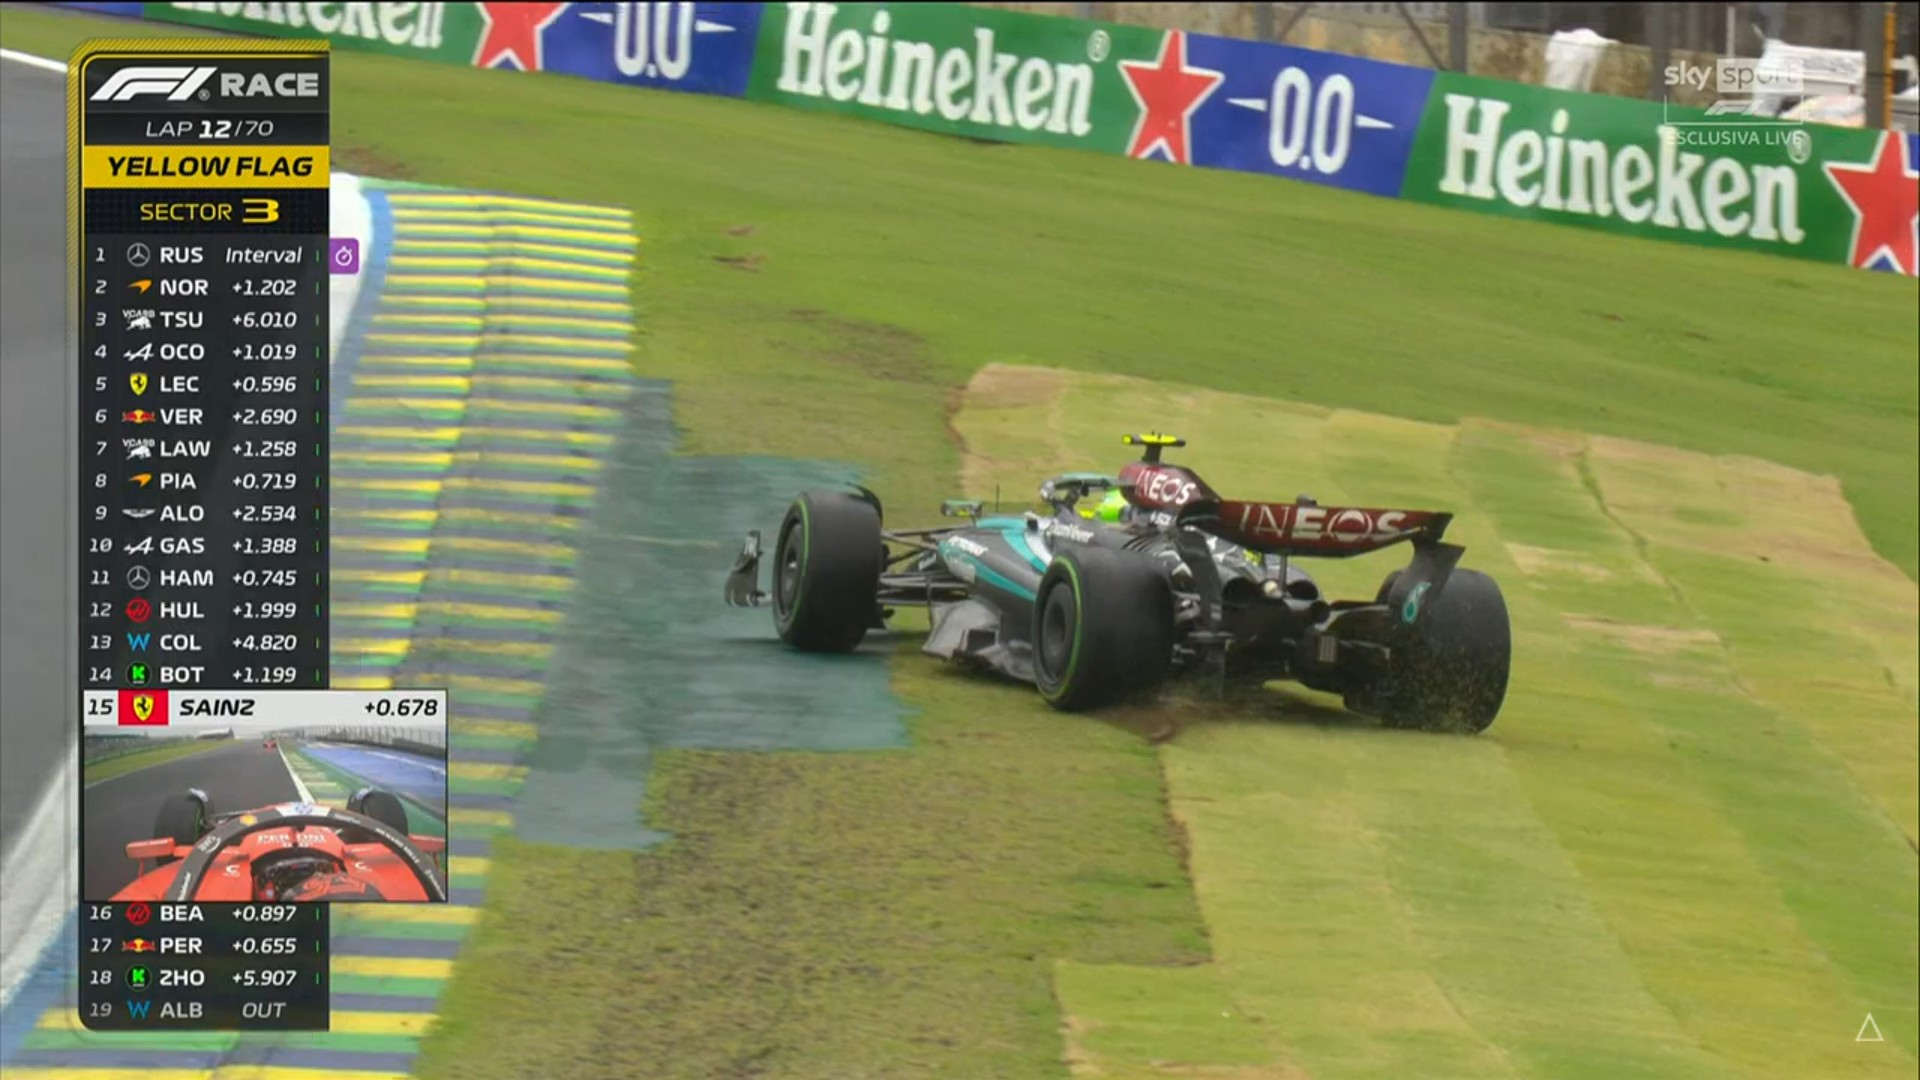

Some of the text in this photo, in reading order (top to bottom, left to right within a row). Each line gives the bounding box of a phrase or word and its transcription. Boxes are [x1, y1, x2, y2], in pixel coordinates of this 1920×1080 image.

[777, 2, 1093, 137] Heineken
[1269, 67, 1355, 174] 0.0
[1439, 93, 1805, 243] Heineken
[1135, 468, 1196, 505] INEOS
[1239, 503, 1408, 543] INEOS
